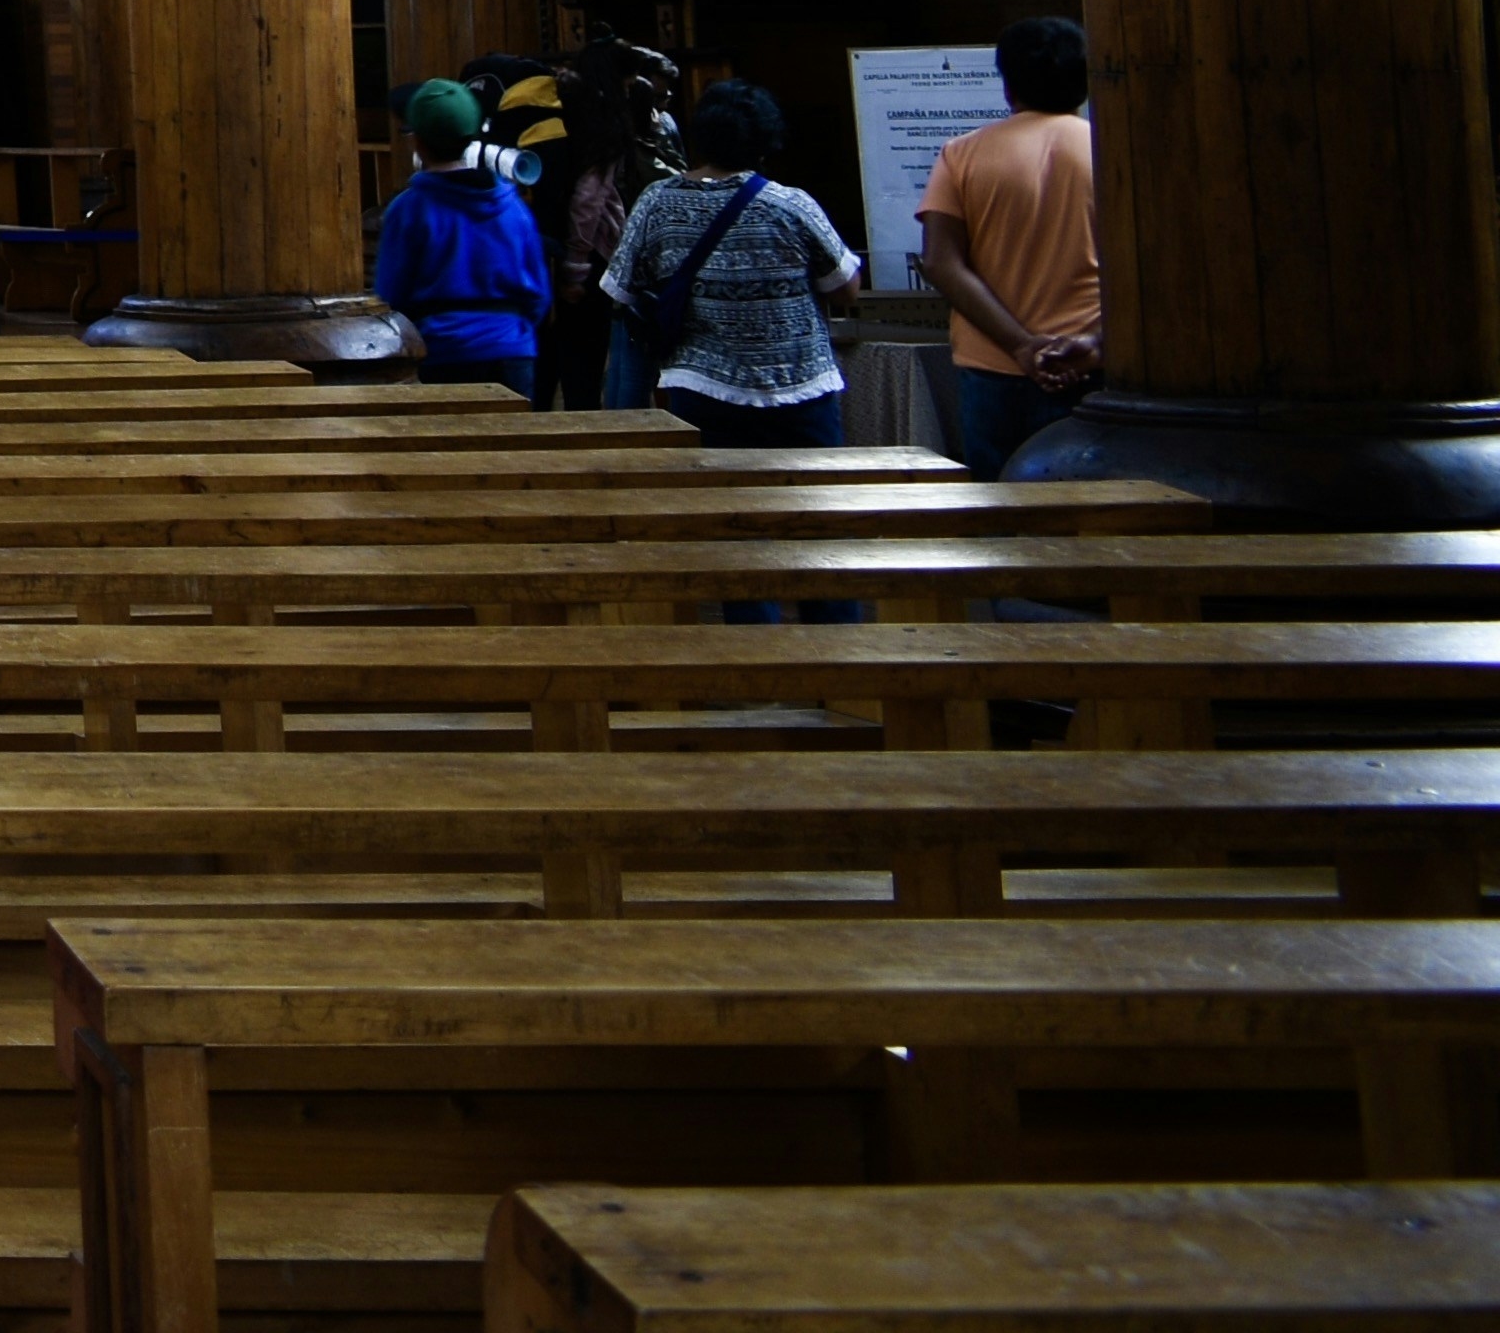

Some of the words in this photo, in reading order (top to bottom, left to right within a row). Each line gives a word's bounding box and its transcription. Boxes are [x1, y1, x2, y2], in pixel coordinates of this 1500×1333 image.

[932, 72, 962, 80] NUESTRA
[963, 70, 990, 79] SEÑORA
[886, 108, 927, 119] CAMPAÑA
[928, 109, 949, 119] PARA
[951, 107, 1011, 119] CONSTRUCCIÓ
